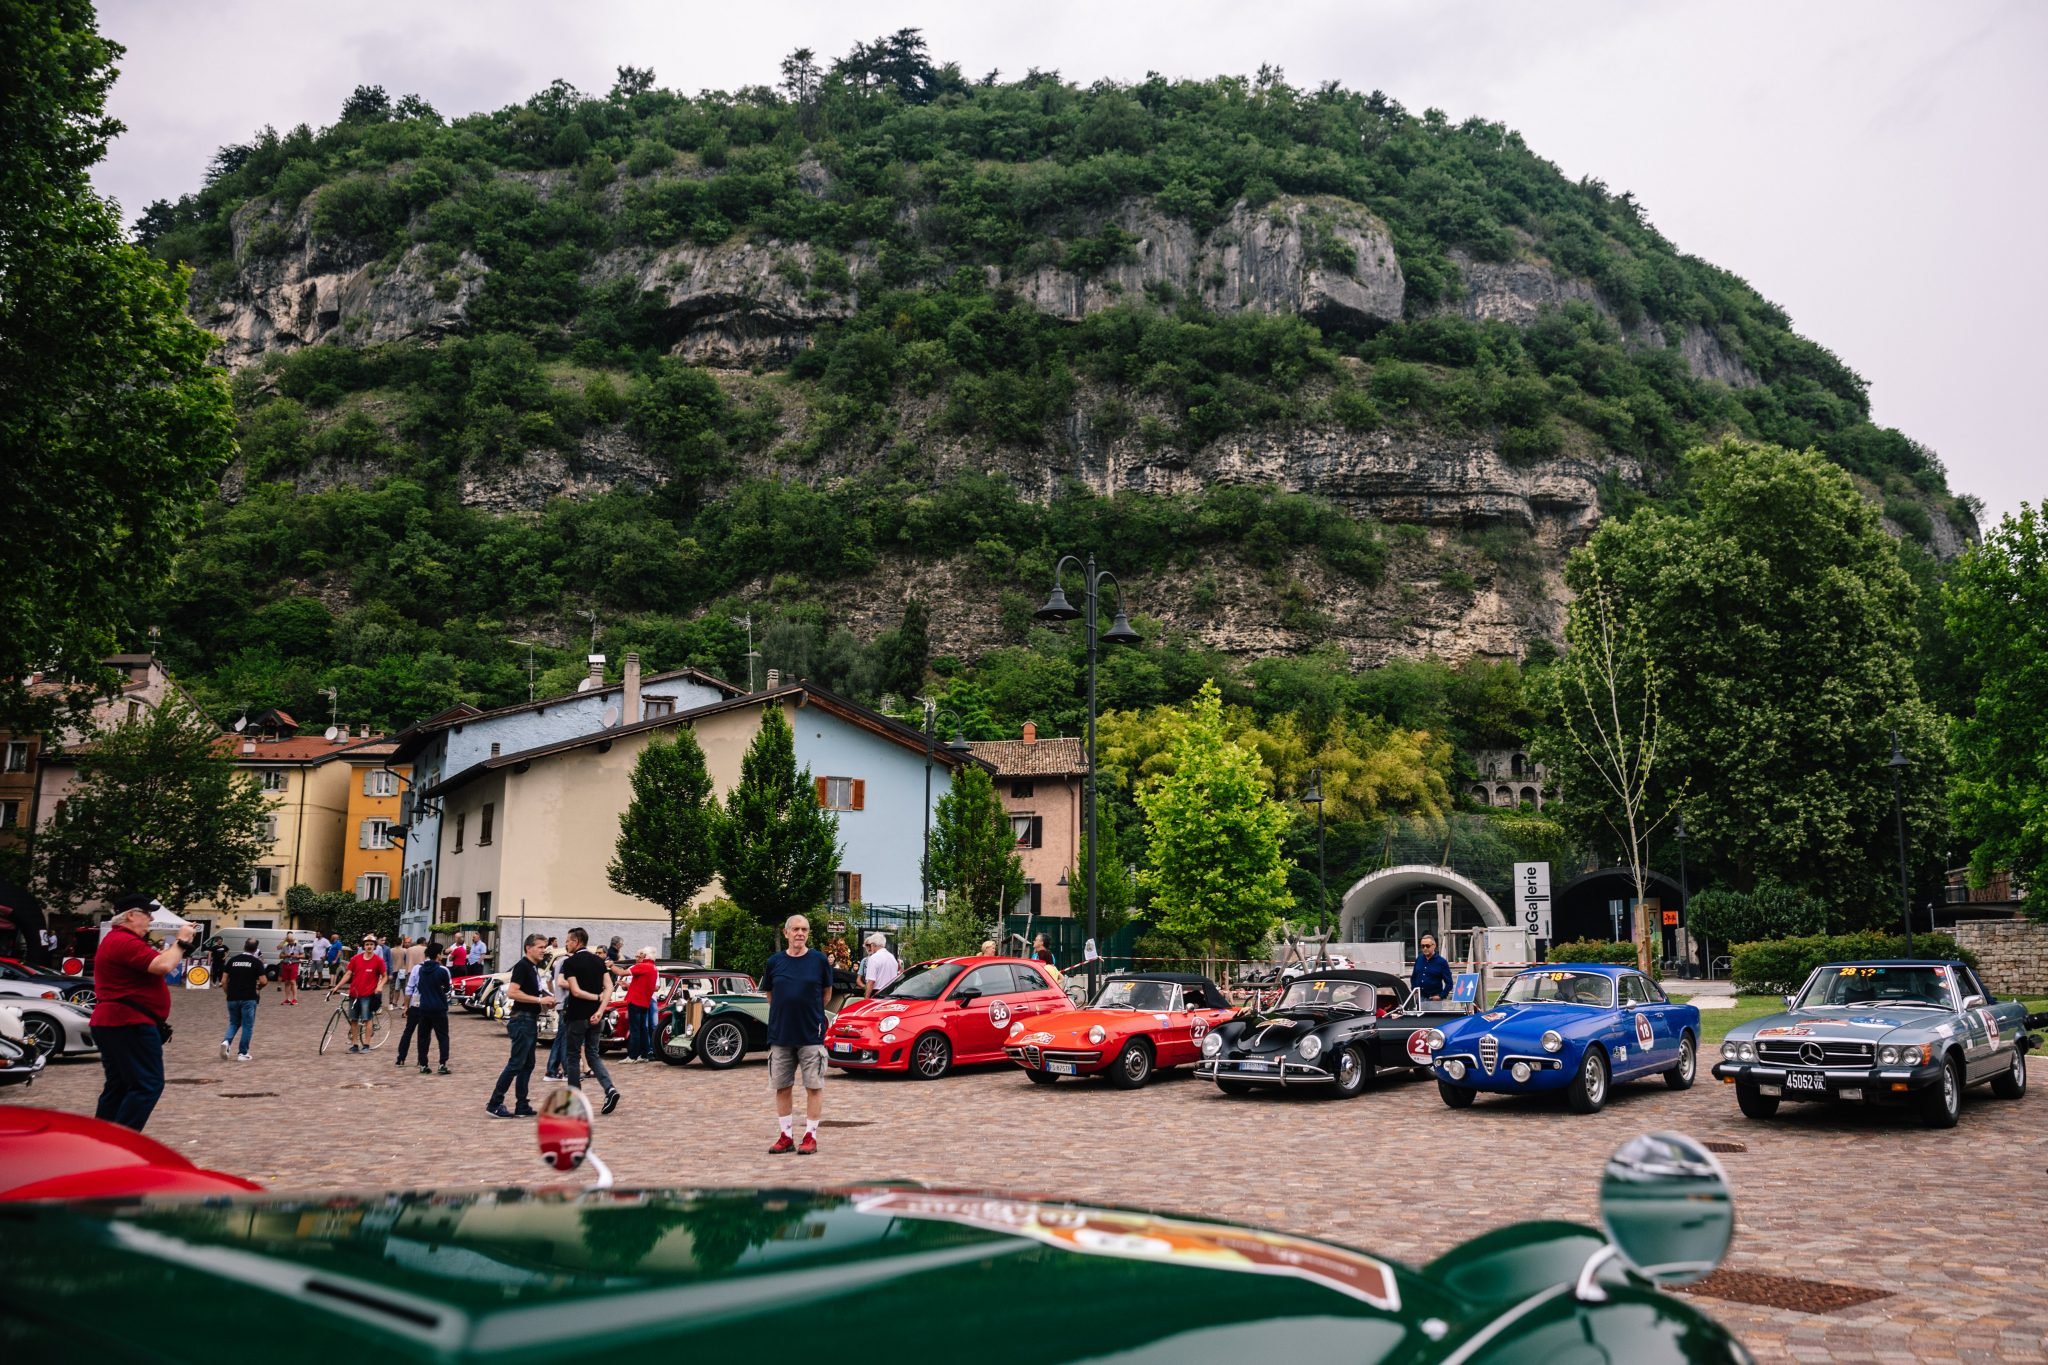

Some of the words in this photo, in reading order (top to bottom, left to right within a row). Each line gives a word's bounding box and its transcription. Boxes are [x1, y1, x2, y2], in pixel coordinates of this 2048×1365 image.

[1523, 867, 1549, 935] leGallerie
[1550, 973, 1563, 981] 18
[1839, 967, 1857, 976] 28
[1312, 981, 1326, 990] 21
[993, 1008, 1007, 1020] 36
[1194, 1025, 1206, 1038] 27
[1639, 1023, 1650, 1039] 18
[1786, 1073, 1813, 1089] 45052
